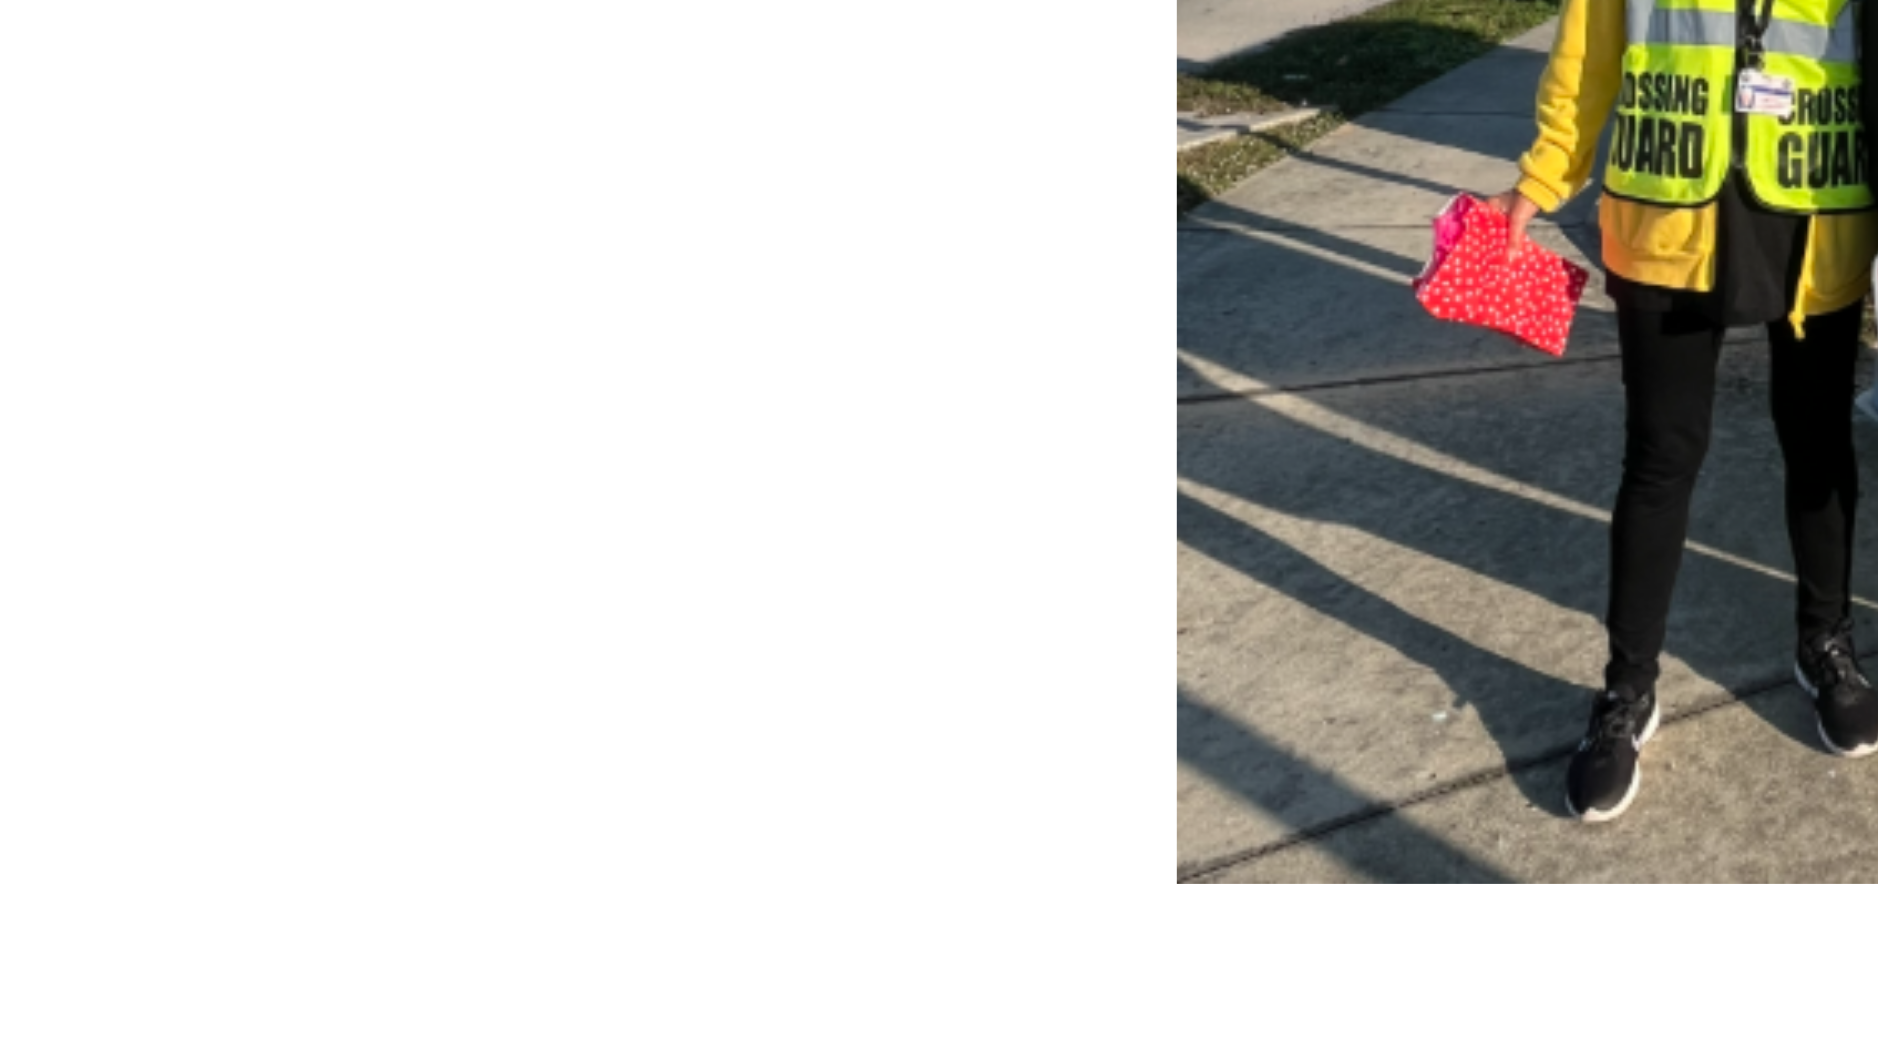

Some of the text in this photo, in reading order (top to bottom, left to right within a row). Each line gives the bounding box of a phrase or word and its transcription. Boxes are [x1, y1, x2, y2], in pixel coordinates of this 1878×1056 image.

[1622, 71, 1709, 116] OSSING
[1778, 87, 1862, 126] ROSS
[1610, 113, 1704, 179] UARD
[1777, 130, 1870, 189] GUAR
